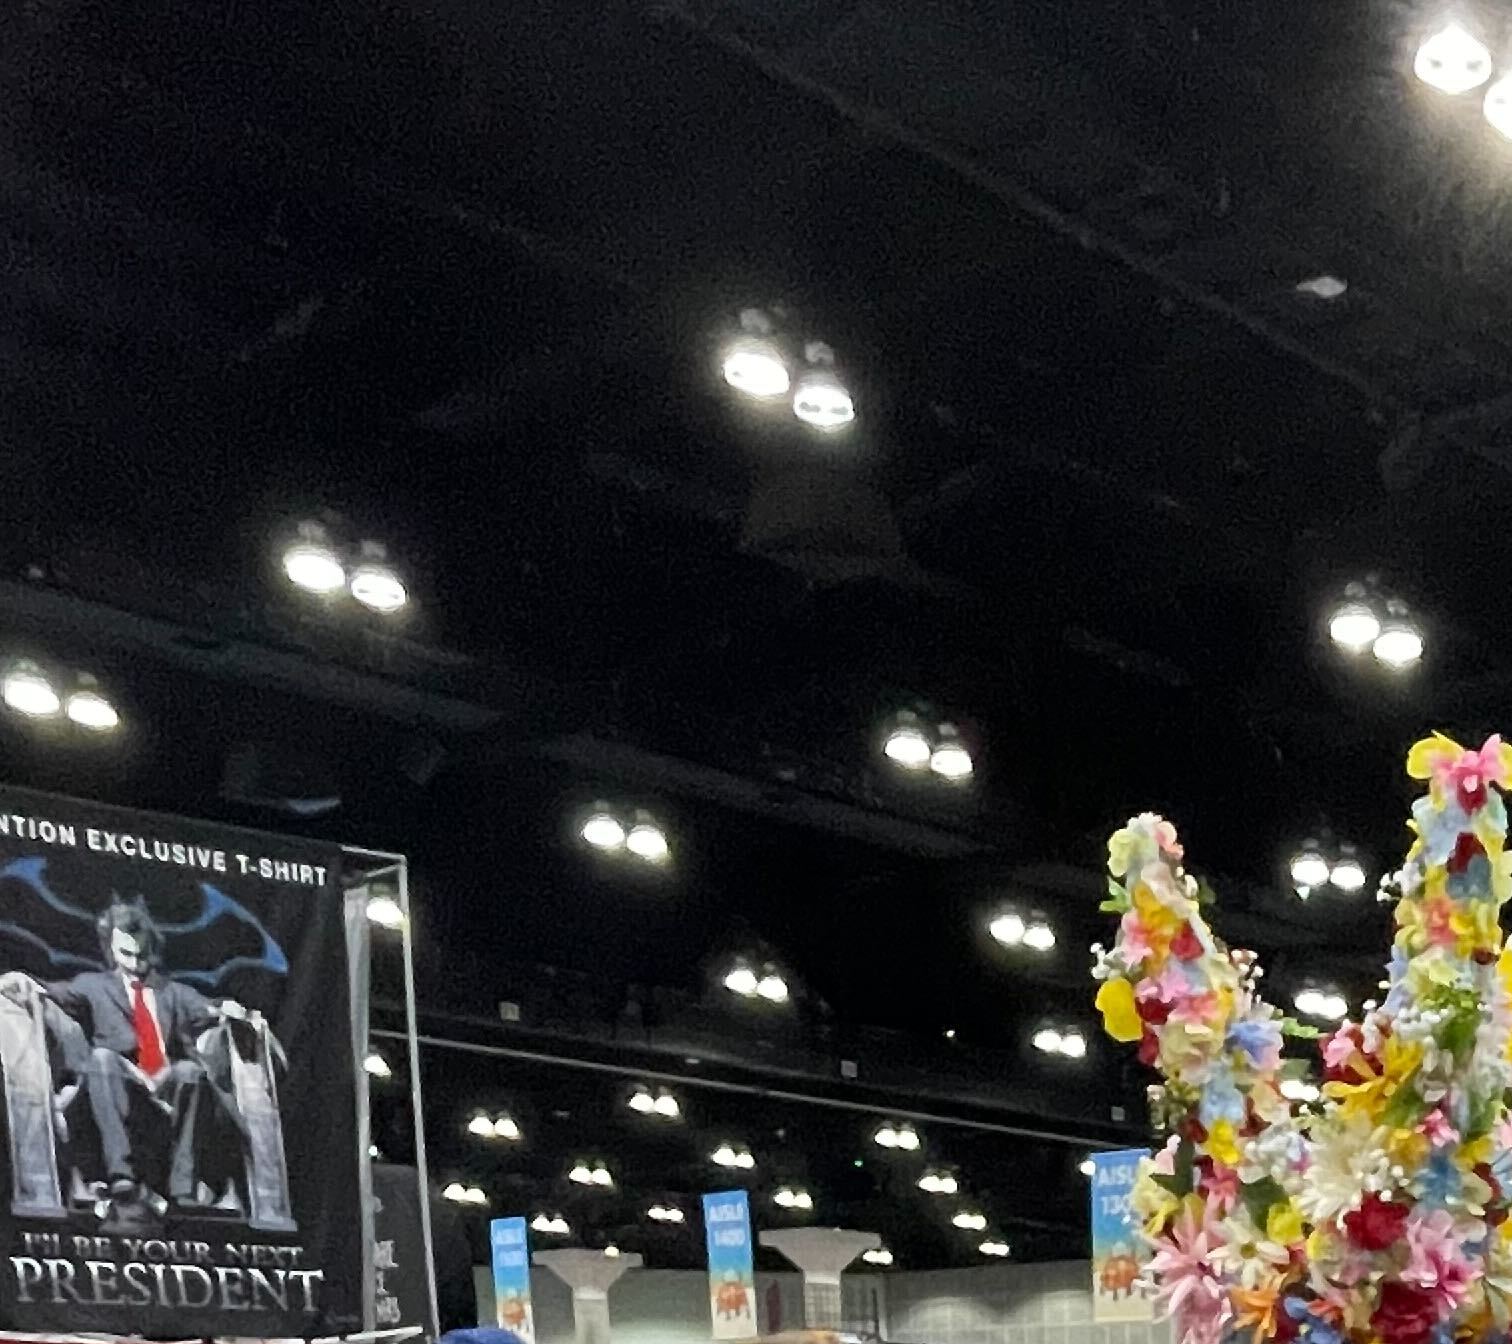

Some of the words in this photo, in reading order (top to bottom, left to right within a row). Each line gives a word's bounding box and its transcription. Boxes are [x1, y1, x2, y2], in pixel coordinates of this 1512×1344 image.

[86, 828, 227, 873] EXCLUSIVE
[235, 854, 327, 887] T-SHIRT
[73, 1236, 111, 1258] BE
[122, 1239, 213, 1263] YOUR
[226, 1243, 304, 1267] NEXT
[8, 1256, 325, 1312] PRESIDENT
